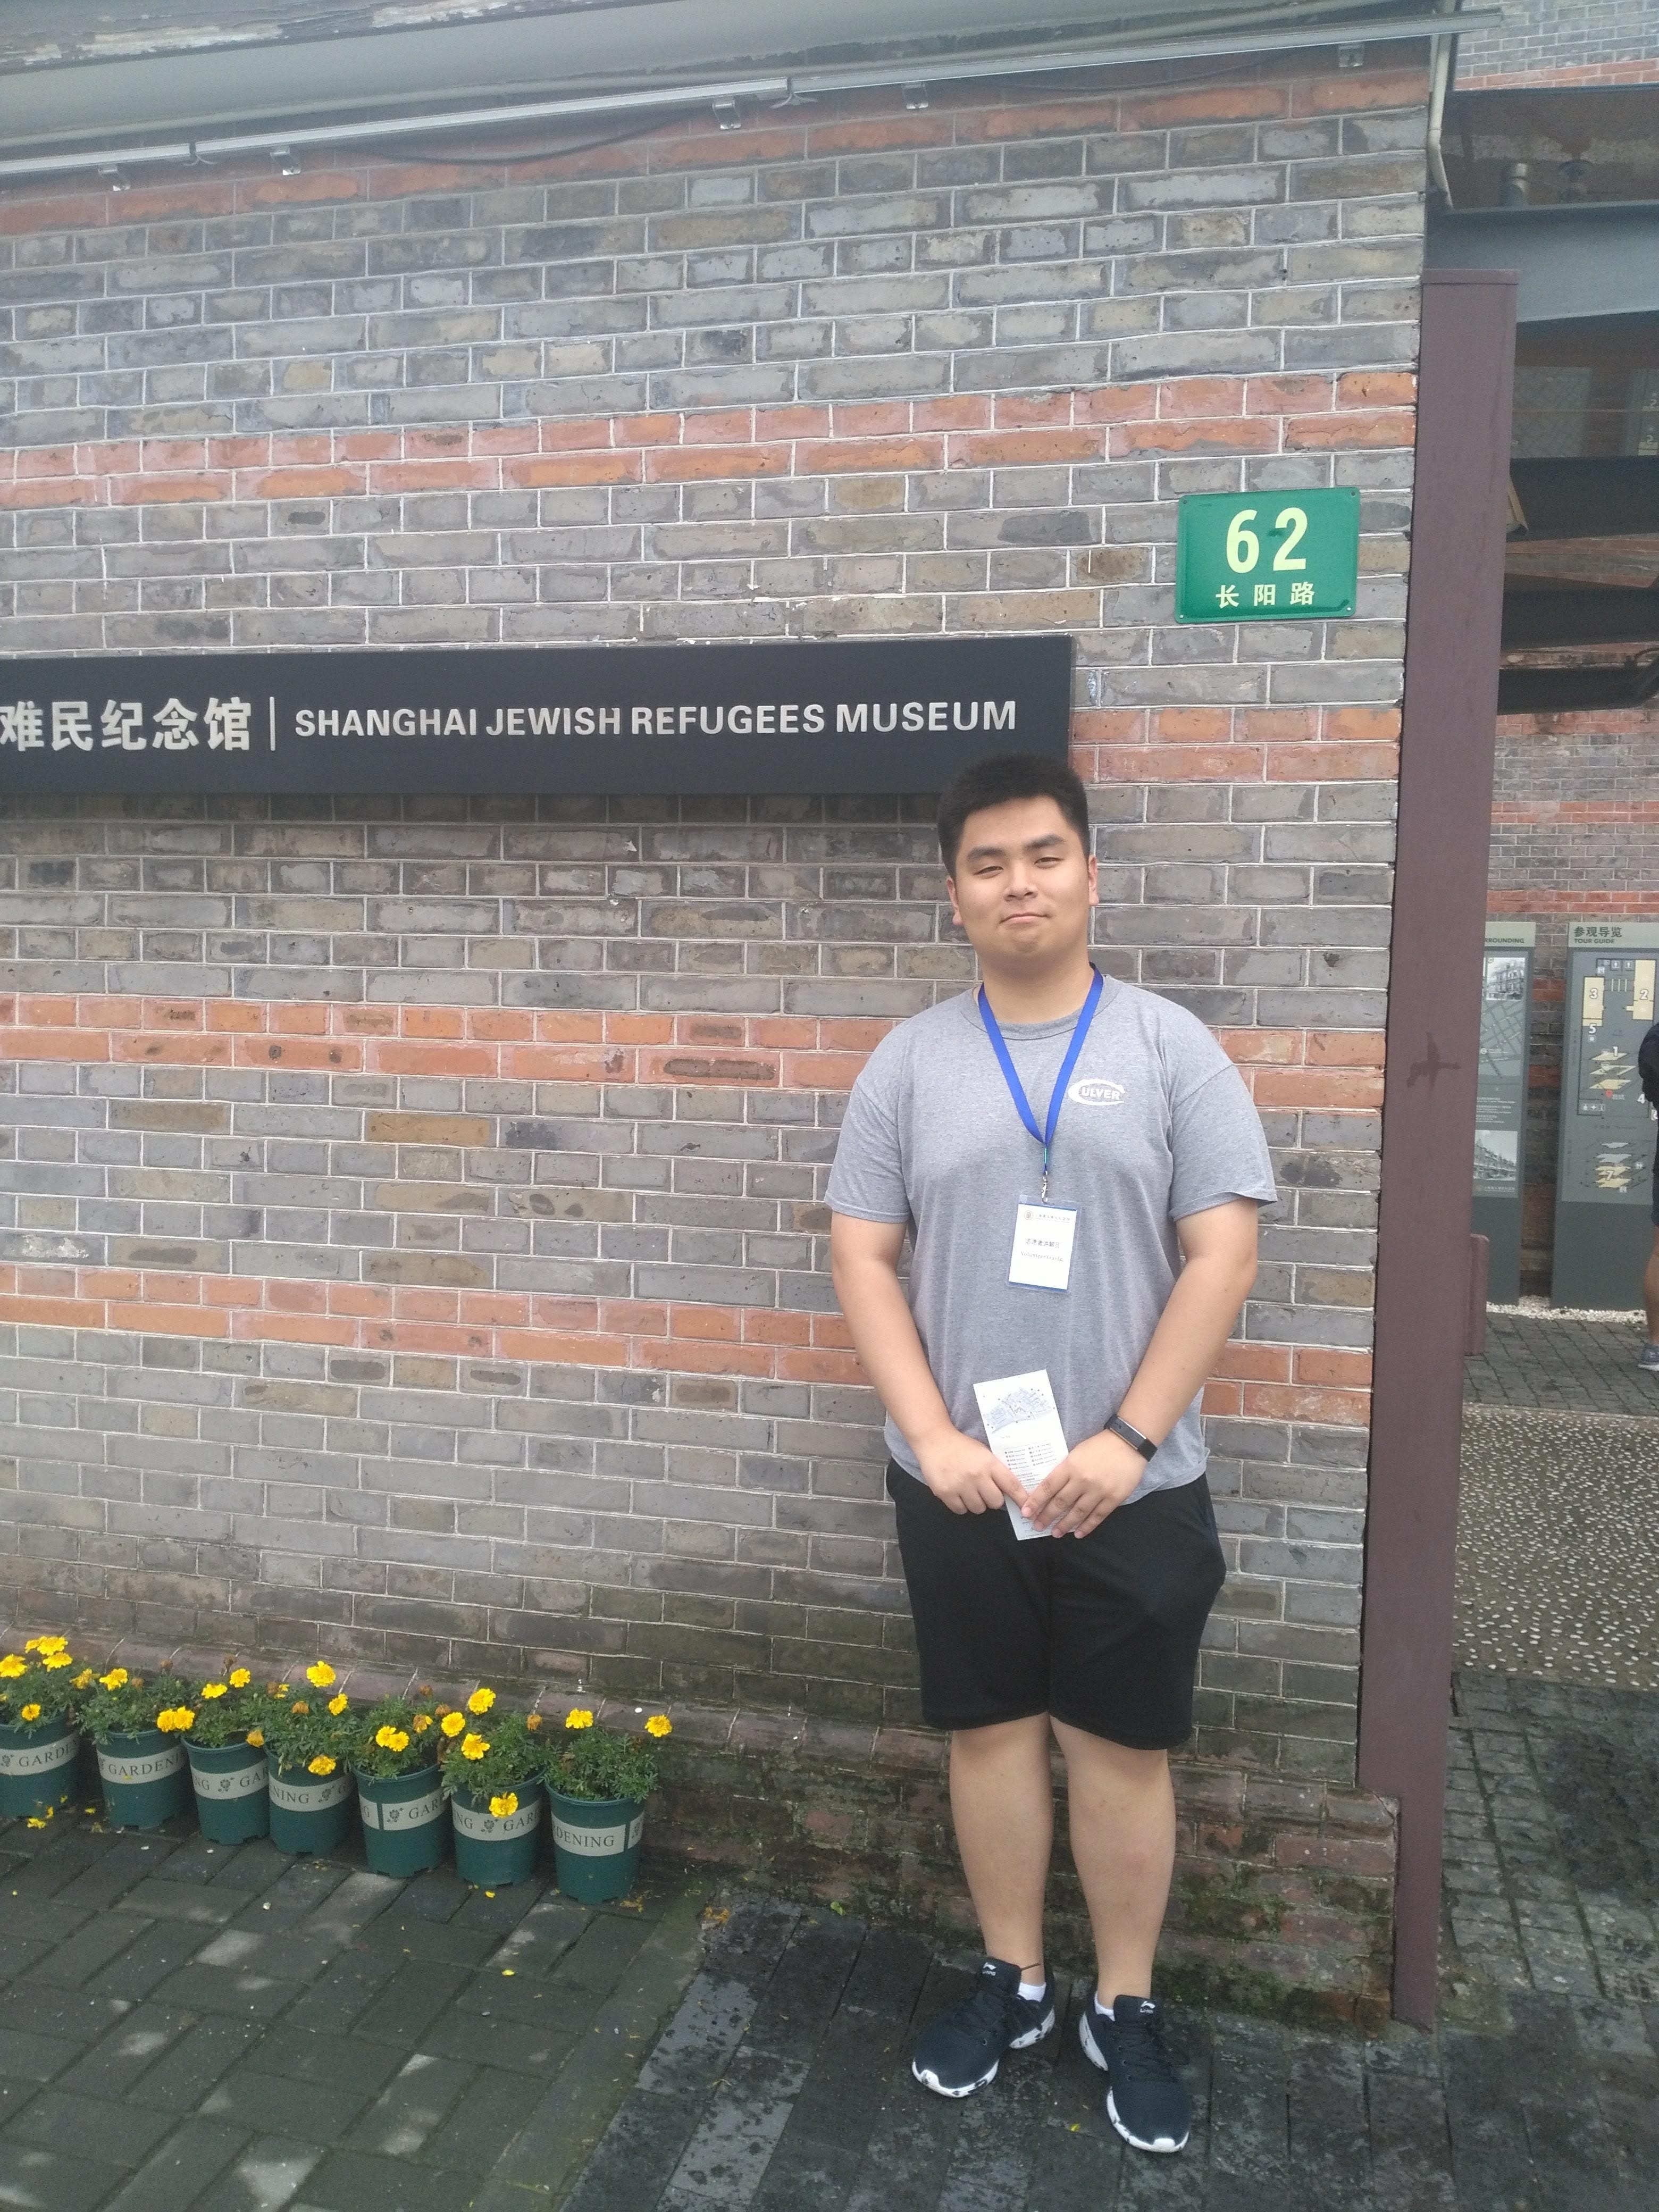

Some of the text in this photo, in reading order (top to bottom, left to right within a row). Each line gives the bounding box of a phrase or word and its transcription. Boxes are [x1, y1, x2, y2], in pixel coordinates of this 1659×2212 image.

[1226, 507, 1308, 573] 62
[1216, 582, 1315, 608] 长阳路
[0, 697, 252, 751] 难民纪念馆
[295, 700, 1016, 737] SHANGHAI JEWISH REFUGEES MUSEUM
[1573, 926, 1622, 937] 参观导览
[1590, 988, 1598, 999] 3
[1640, 989, 1648, 1000] 2
[1589, 1023, 1596, 1034] 5
[1613, 1046, 1618, 1057] 1
[1068, 1078, 1126, 1106] CULVER
[1637, 1094, 1645, 1104] 4
[1607, 1170, 1614, 1180] 7
